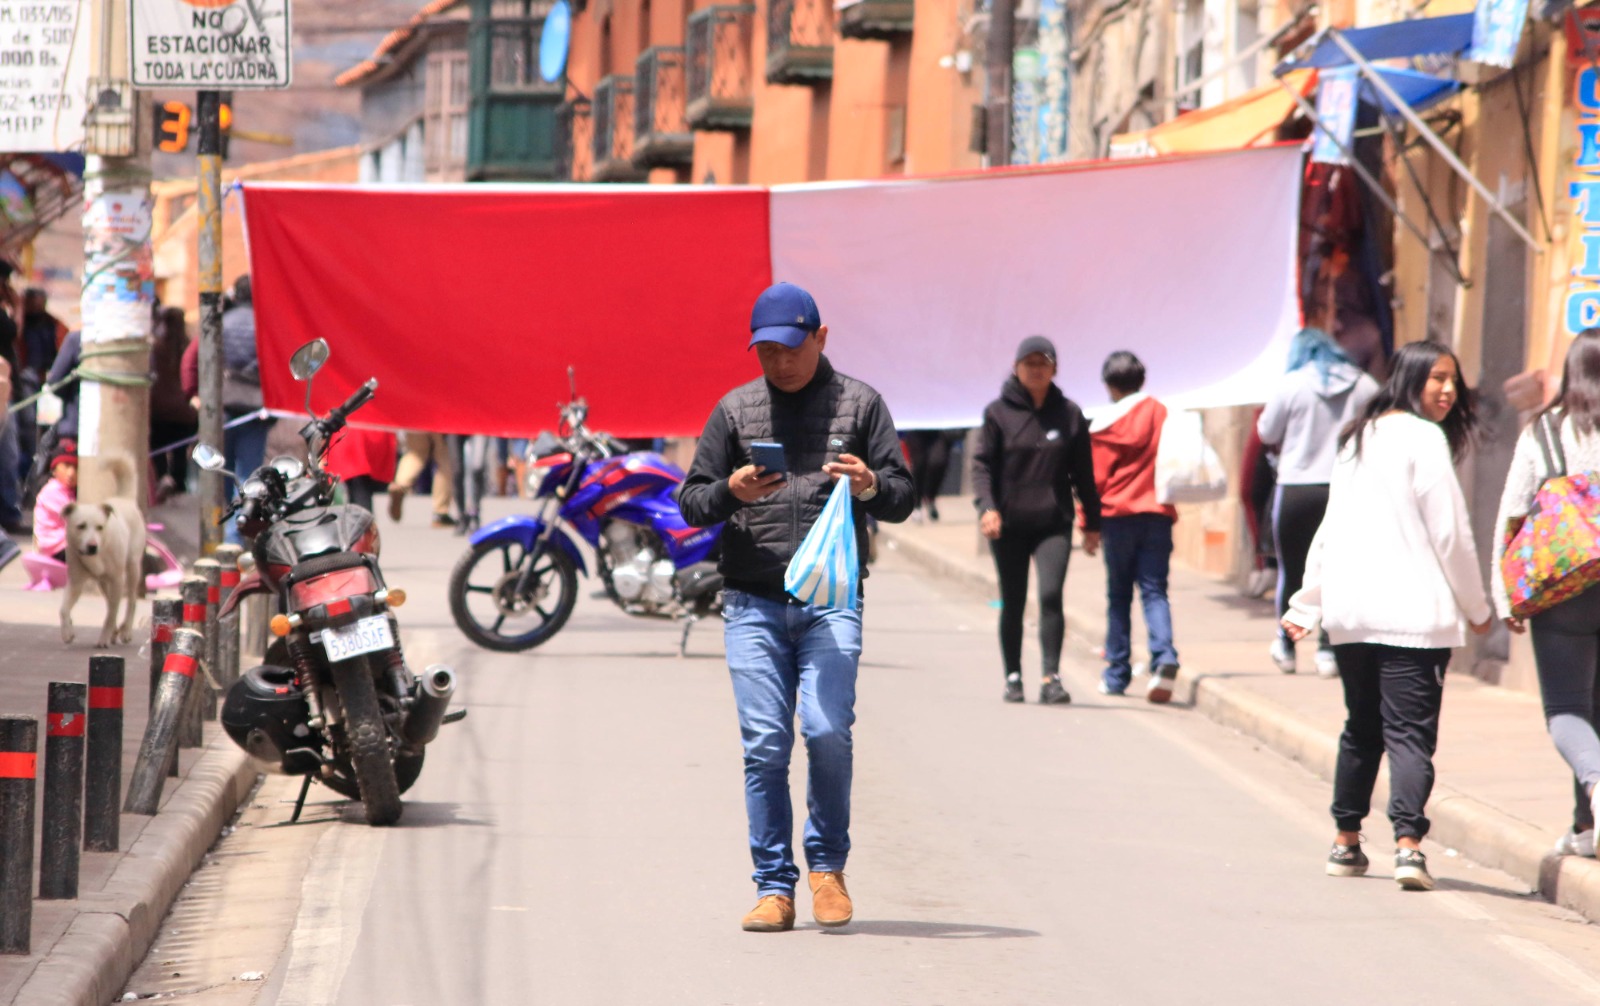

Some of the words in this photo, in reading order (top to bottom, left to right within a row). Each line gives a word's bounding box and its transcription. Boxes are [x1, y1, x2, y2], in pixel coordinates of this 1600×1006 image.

[192, 11, 223, 29] NO
[12, 28, 30, 45] de
[147, 35, 272, 54] ESTACIONAR
[144, 61, 185, 80] TODA
[190, 61, 209, 80] LA
[214, 61, 279, 81] CUADRA
[330, 627, 385, 657] 5380SAF
